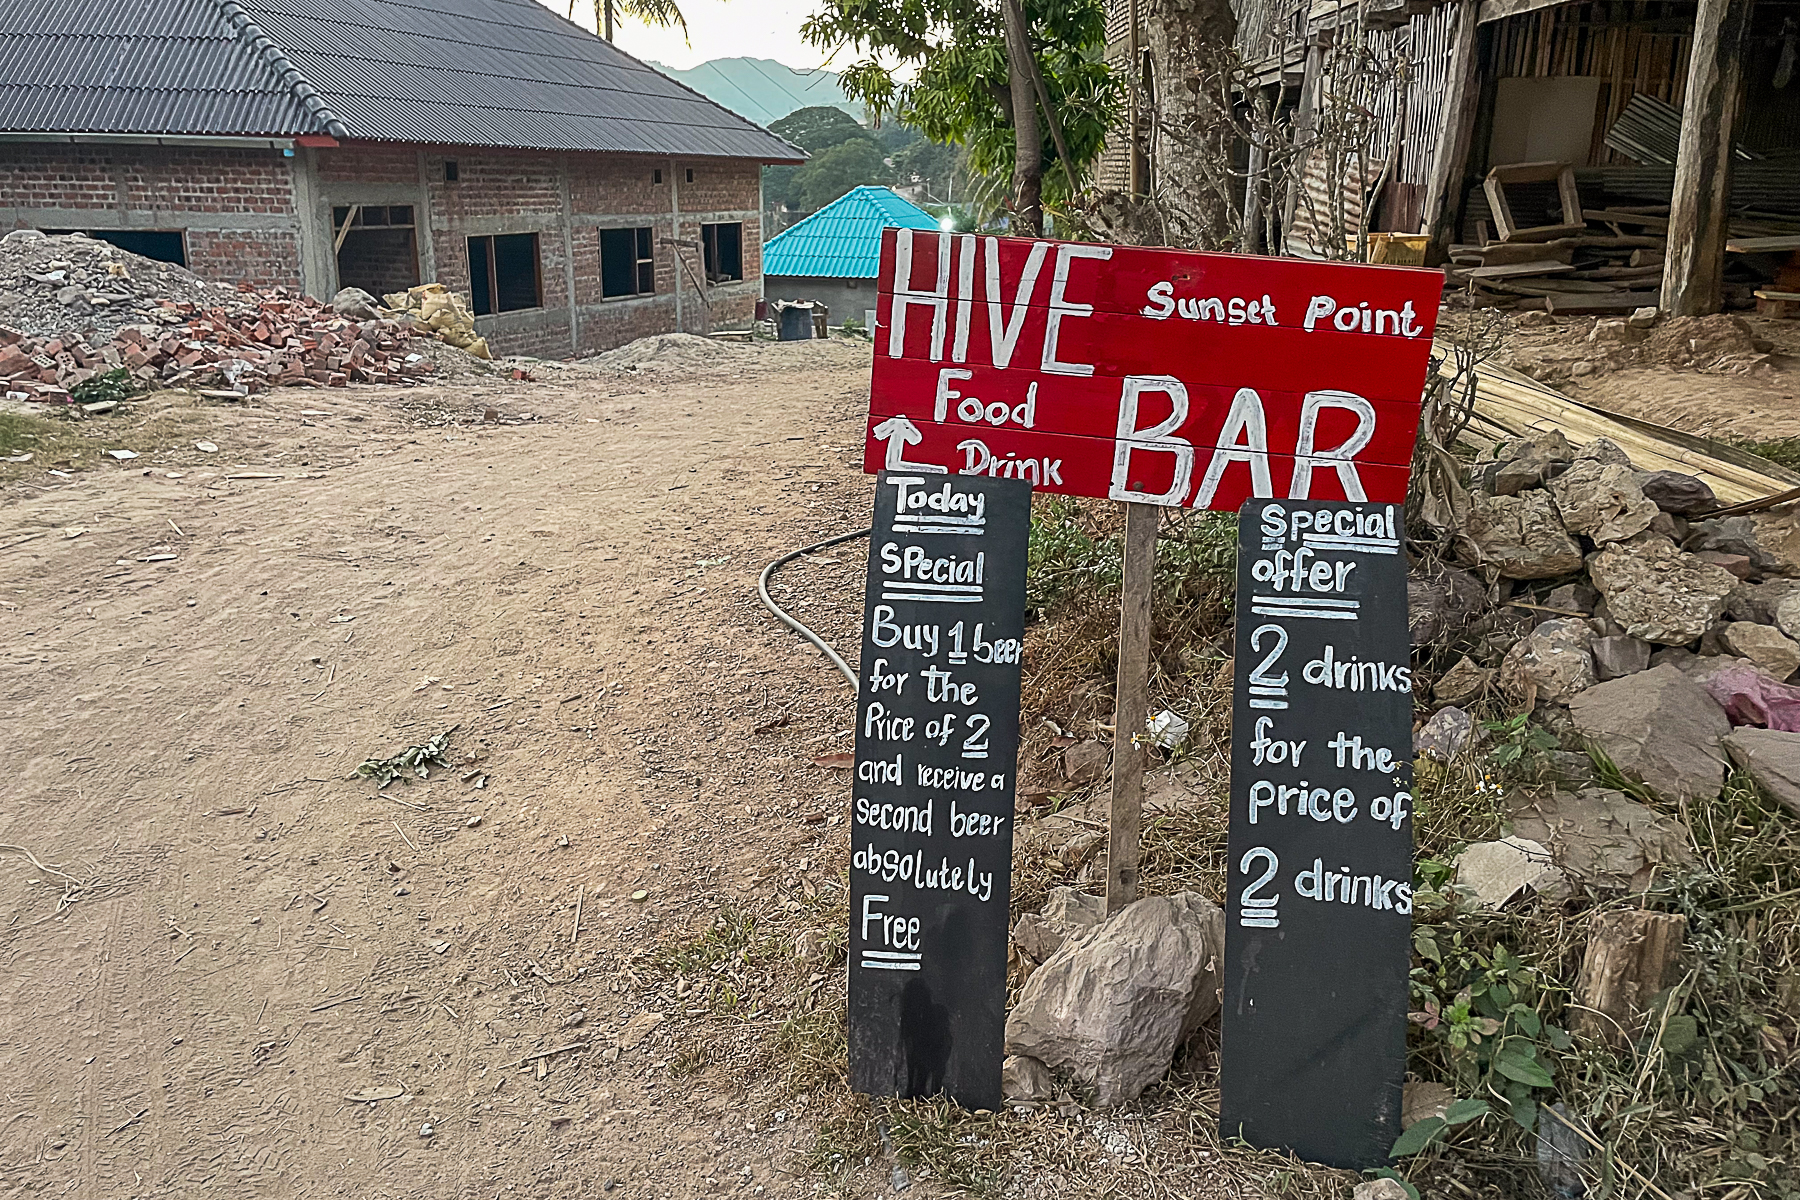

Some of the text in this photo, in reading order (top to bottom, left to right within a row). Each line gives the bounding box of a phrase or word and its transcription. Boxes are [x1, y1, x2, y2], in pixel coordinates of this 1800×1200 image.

[889, 228, 1113, 376] HIVE
[1139, 281, 1423, 340] Sunset Point
[934, 368, 1038, 429] Food
[956, 439, 1063, 486] Drink
[1109, 374, 1376, 509] BAR
[886, 476, 986, 521] Today
[1260, 504, 1396, 541] Special
[1252, 547, 1357, 592] offer
[871, 604, 1023, 665] Buy 1 beer
[1249, 623, 1412, 694] 2 drinks
[869, 658, 978, 706] for the
[864, 701, 991, 750] Price of 2
[1250, 715, 1396, 774] for the
[858, 754, 1005, 791] and receive a
[856, 798, 1005, 838] second beer
[1249, 780, 1412, 830] price of
[853, 842, 993, 902] absolutely
[1240, 846, 1413, 915] 2 drinks
[861, 894, 921, 951] Free
